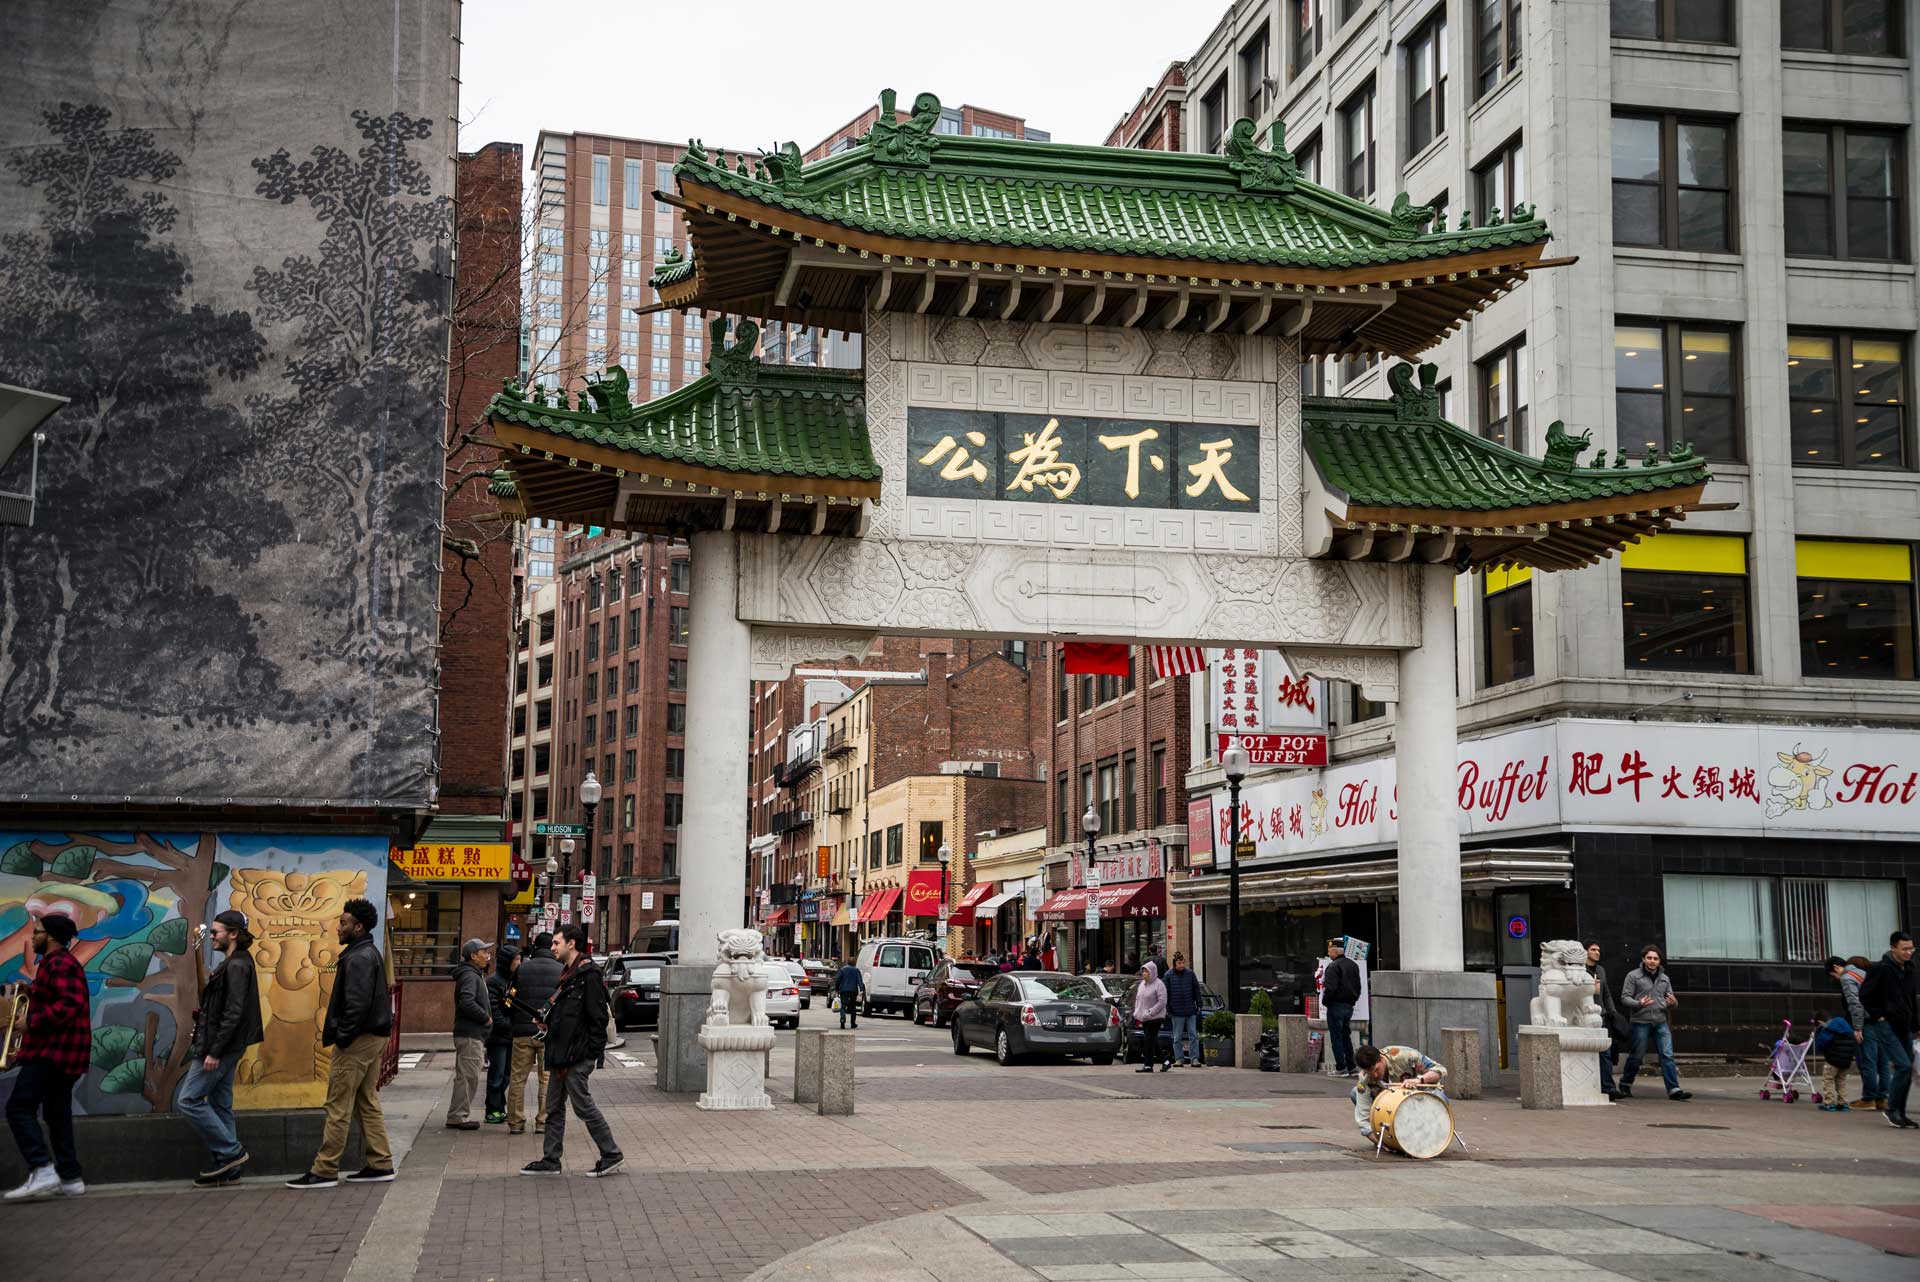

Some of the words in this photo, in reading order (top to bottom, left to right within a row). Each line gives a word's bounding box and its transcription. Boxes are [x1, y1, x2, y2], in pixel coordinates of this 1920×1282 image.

[1278, 674, 1315, 714] 城
[1229, 736, 1268, 750] OT
[1279, 736, 1318, 750] POT
[1250, 750, 1307, 763] UFFET
[1457, 755, 1548, 822] Buffet
[1568, 750, 1760, 804] 肥牛火鍋城
[1835, 763, 1918, 805] Hot
[1335, 779, 1378, 828] Hot
[547, 825, 572, 833] HUDSON
[402, 866, 445, 877] SHING
[451, 867, 504, 877] PASTRY
[1130, 906, 1159, 916] 新金門
